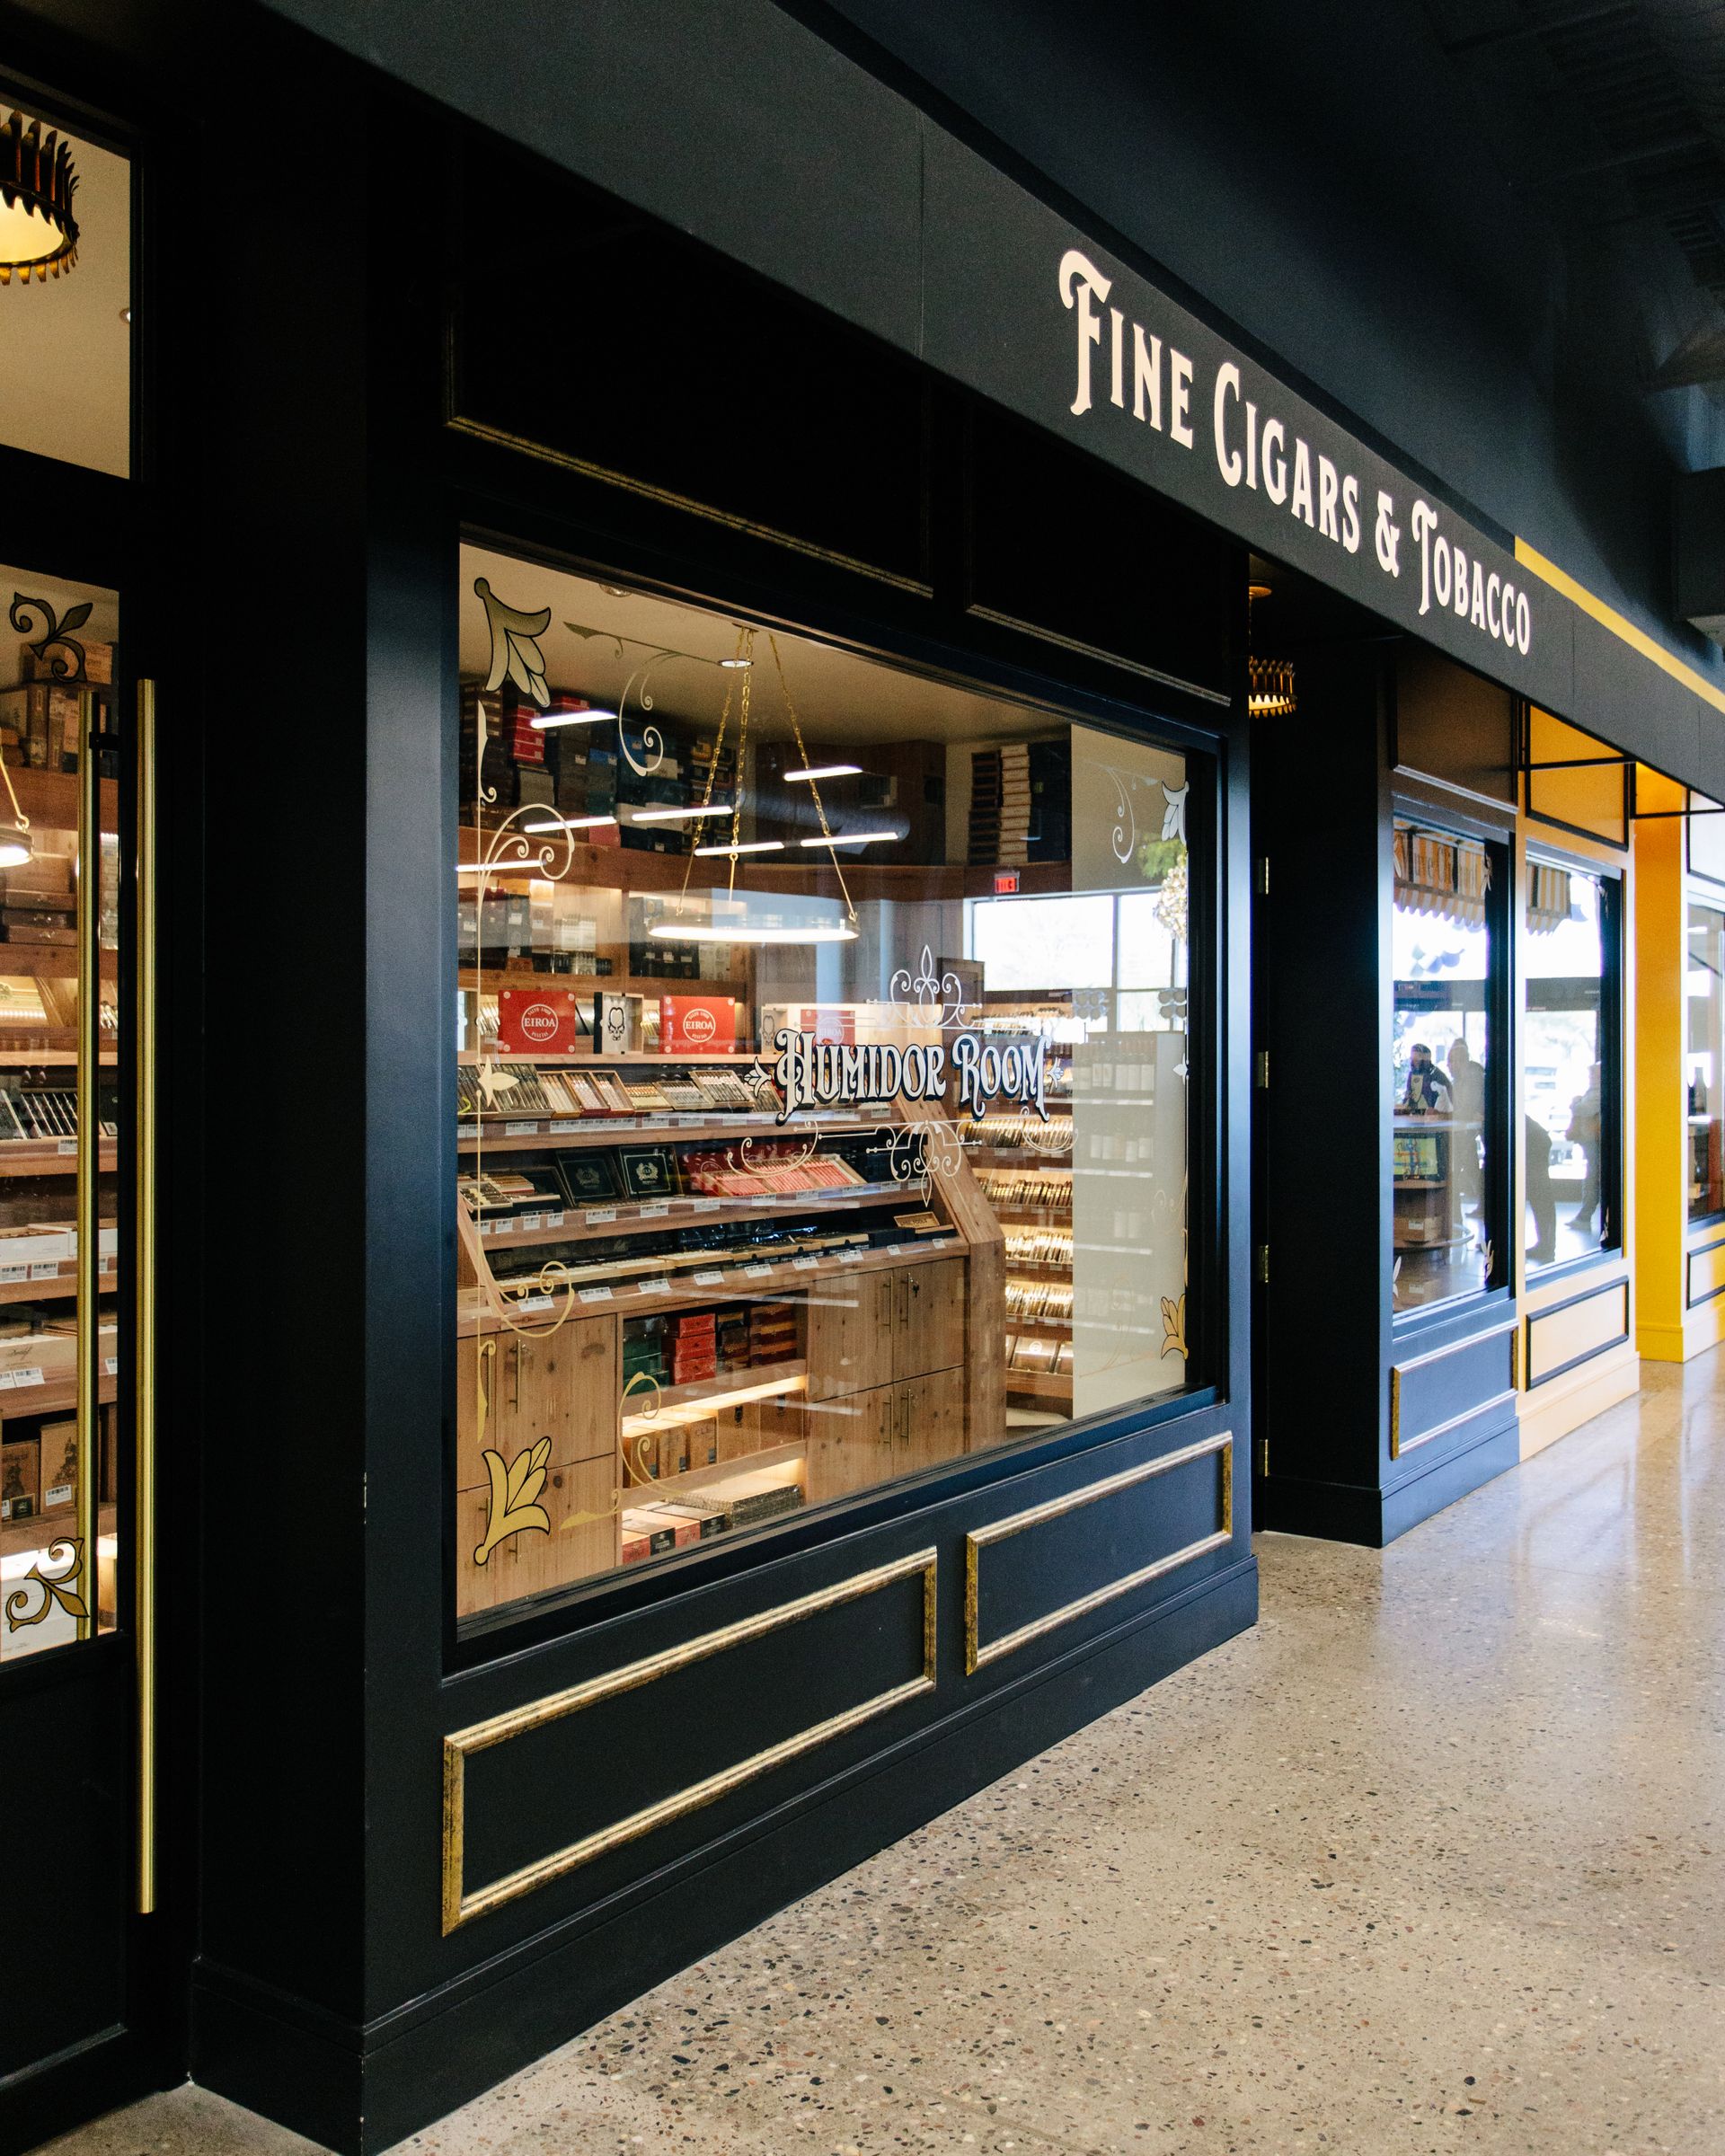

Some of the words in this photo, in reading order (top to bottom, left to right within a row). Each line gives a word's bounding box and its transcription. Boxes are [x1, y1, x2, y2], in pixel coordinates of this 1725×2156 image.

[1059, 250, 1193, 449] FINE
[1214, 362, 1360, 553] CIGARS
[1375, 490, 1400, 578] &
[1411, 499, 1530, 655] TOBACCO
[524, 1017, 556, 1028] EIROA
[685, 1021, 713, 1029] EIROA
[774, 1029, 947, 1127] HUMIDOR
[951, 1033, 1051, 1123] ROOM
